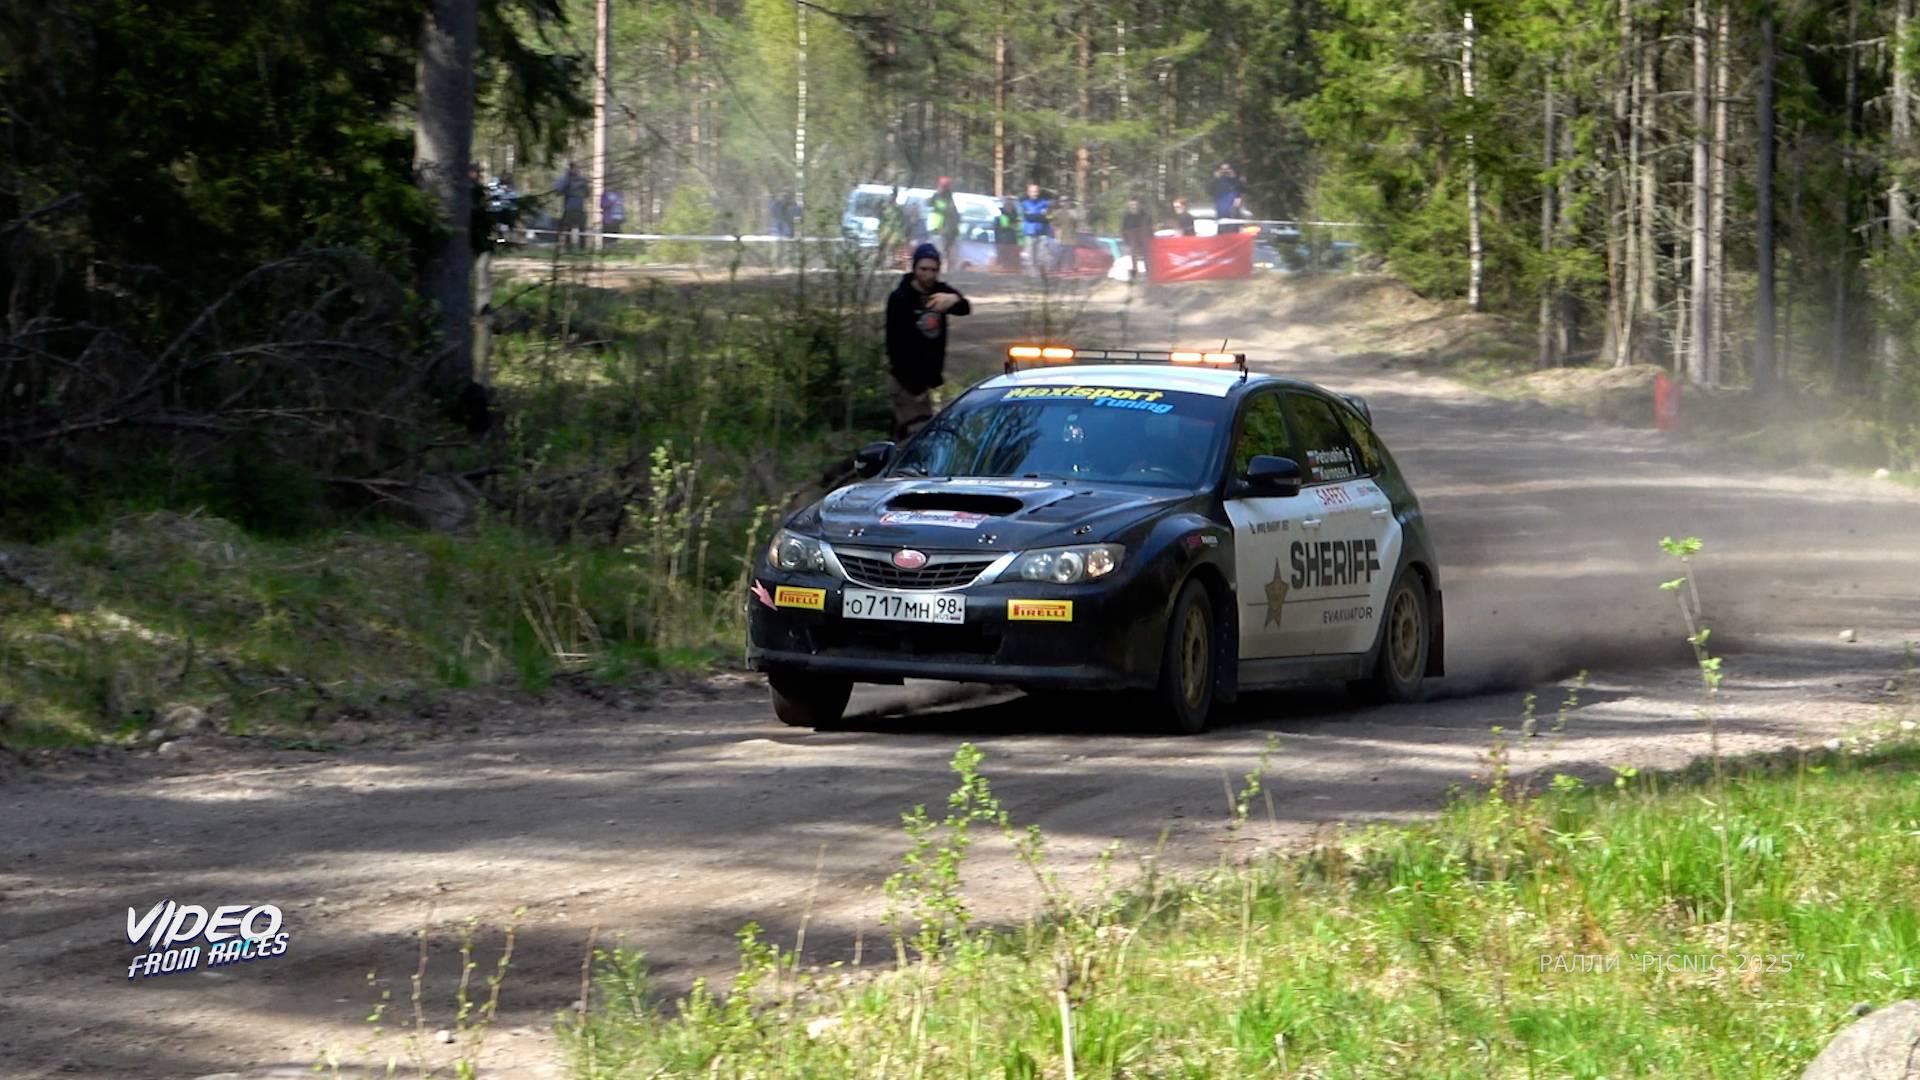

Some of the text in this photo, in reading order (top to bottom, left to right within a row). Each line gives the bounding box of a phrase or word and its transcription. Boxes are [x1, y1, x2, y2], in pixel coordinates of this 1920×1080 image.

[1005, 386, 1163, 402] Maxisport
[1093, 396, 1174, 414] Tuning
[1315, 487, 1352, 506] SAFETY
[1290, 538, 1381, 590] SHERIFF
[936, 597, 957, 614] 98
[1012, 603, 1066, 617] PIRELLI
[1323, 606, 1373, 624] EVAKUATOR
